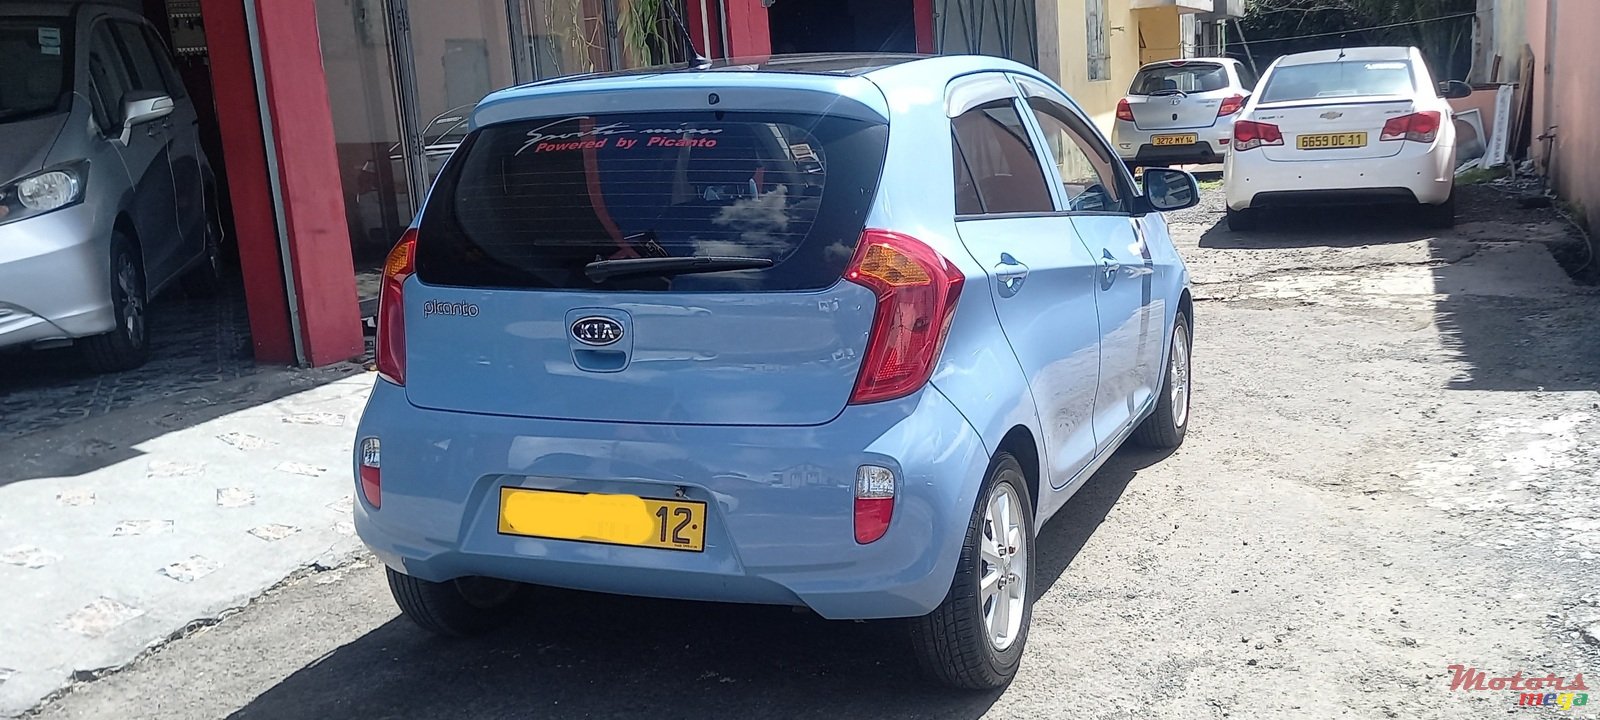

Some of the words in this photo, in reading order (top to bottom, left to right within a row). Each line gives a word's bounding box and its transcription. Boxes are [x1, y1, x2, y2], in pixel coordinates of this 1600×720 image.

[535, 138, 608, 152] Powered
[616, 137, 637, 149] by
[647, 136, 717, 147] Picanto
[1302, 136, 1328, 147] 6659
[1348, 134, 1361, 145] 11
[424, 299, 479, 319] picanto
[580, 323, 615, 339] KIA
[656, 506, 692, 544] 12
